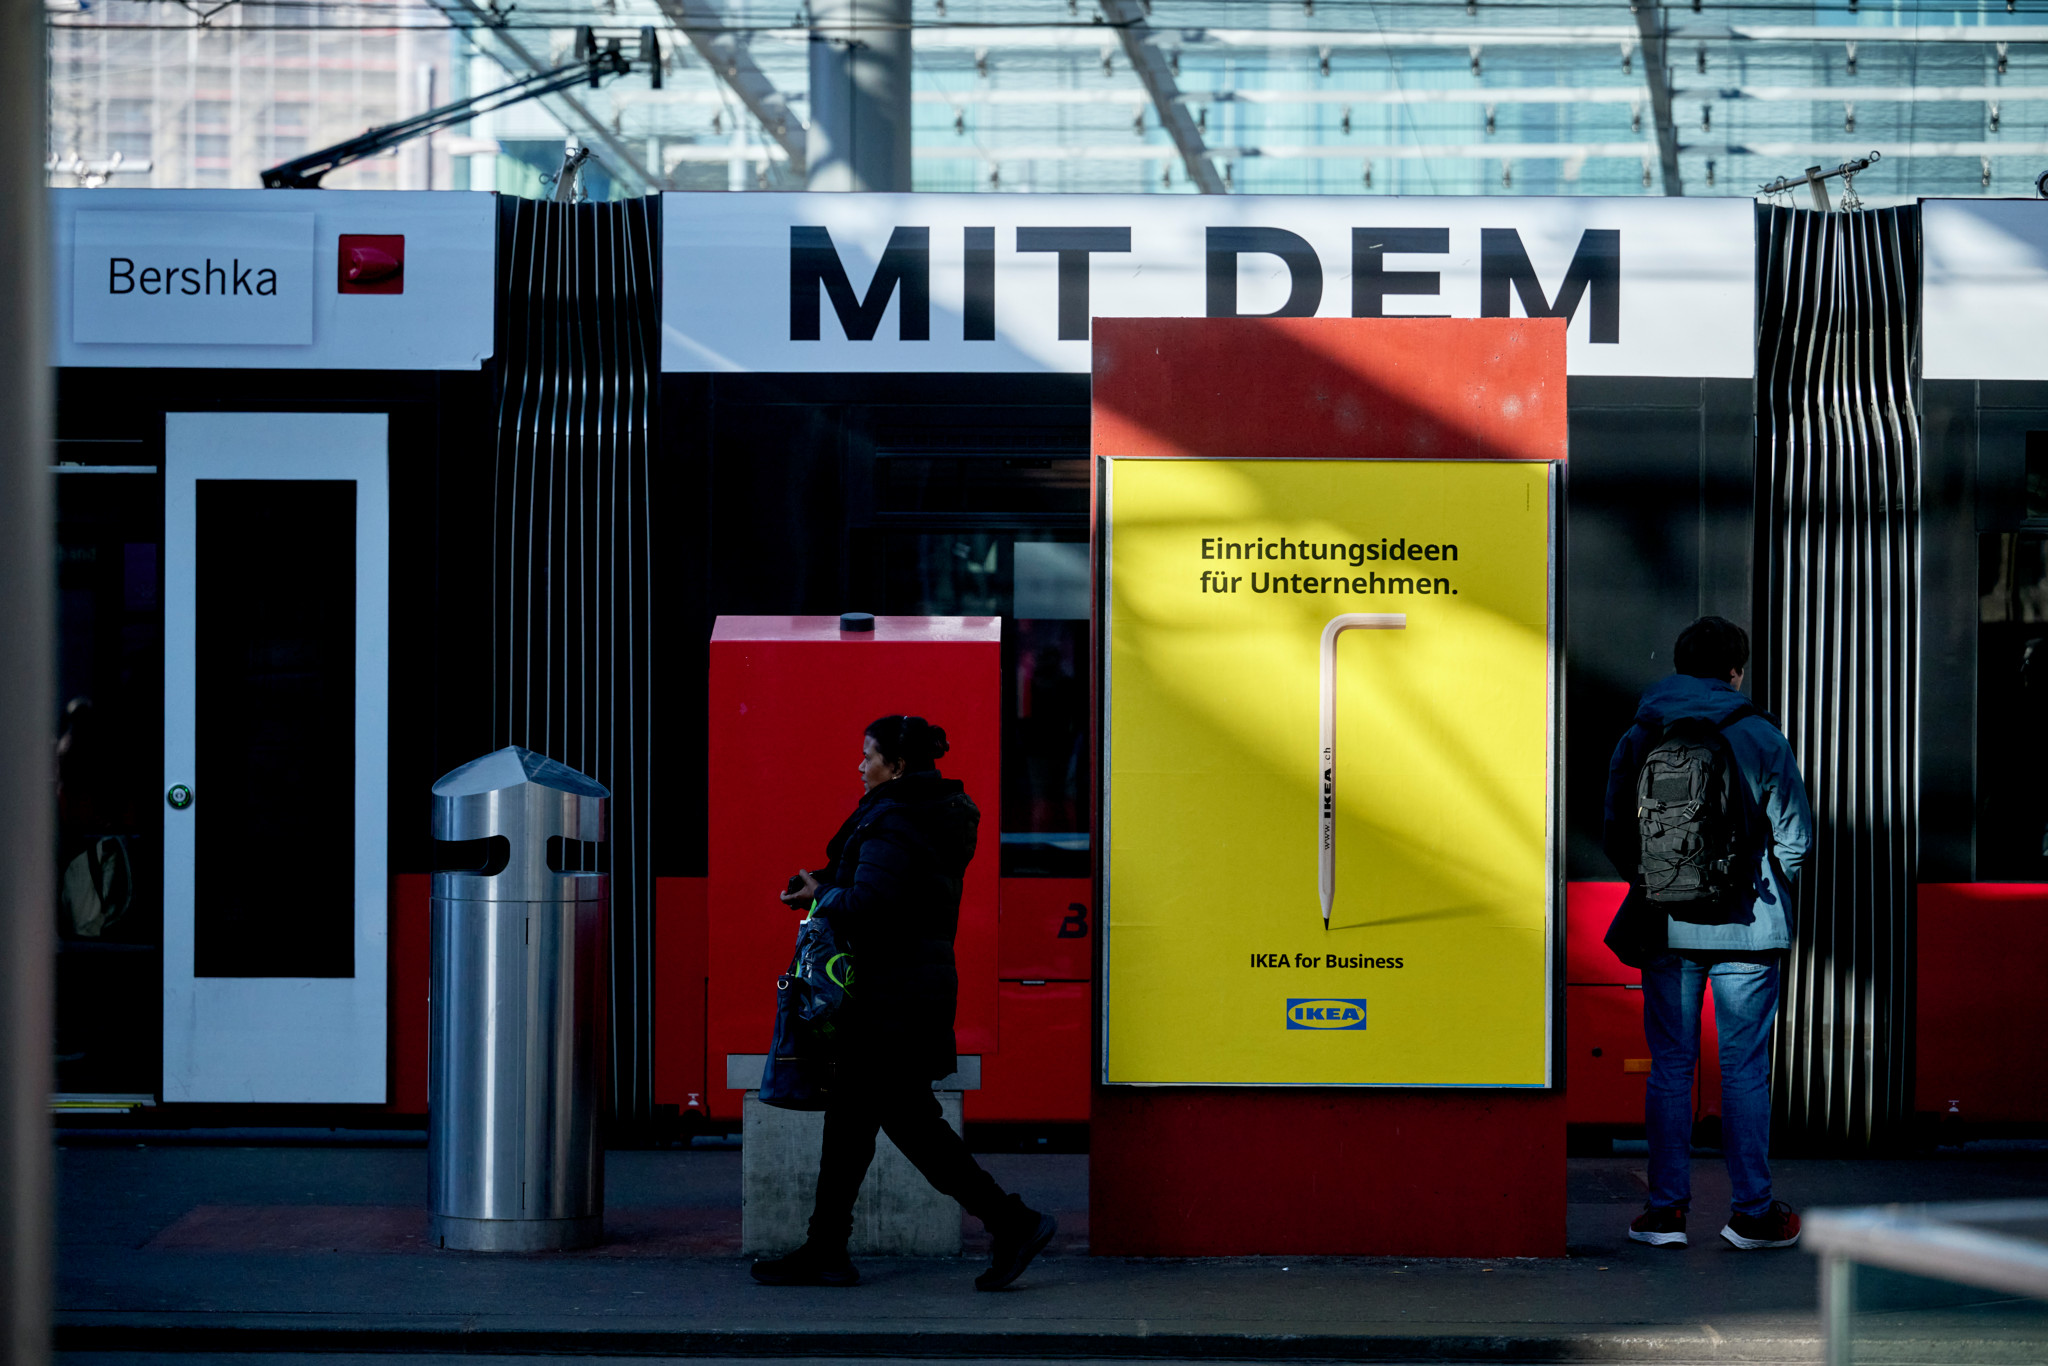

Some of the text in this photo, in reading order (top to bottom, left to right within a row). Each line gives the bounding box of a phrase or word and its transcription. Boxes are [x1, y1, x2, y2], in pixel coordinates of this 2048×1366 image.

[109, 257, 277, 296] Bershka
[790, 226, 1621, 344] MIT DEM
[1201, 537, 1458, 567] Einrichtungsideen
[1200, 570, 1459, 595] für Unternehmen.
[1250, 953, 1404, 969] IKEA for Business
[1295, 1007, 1361, 1021] IKEA
